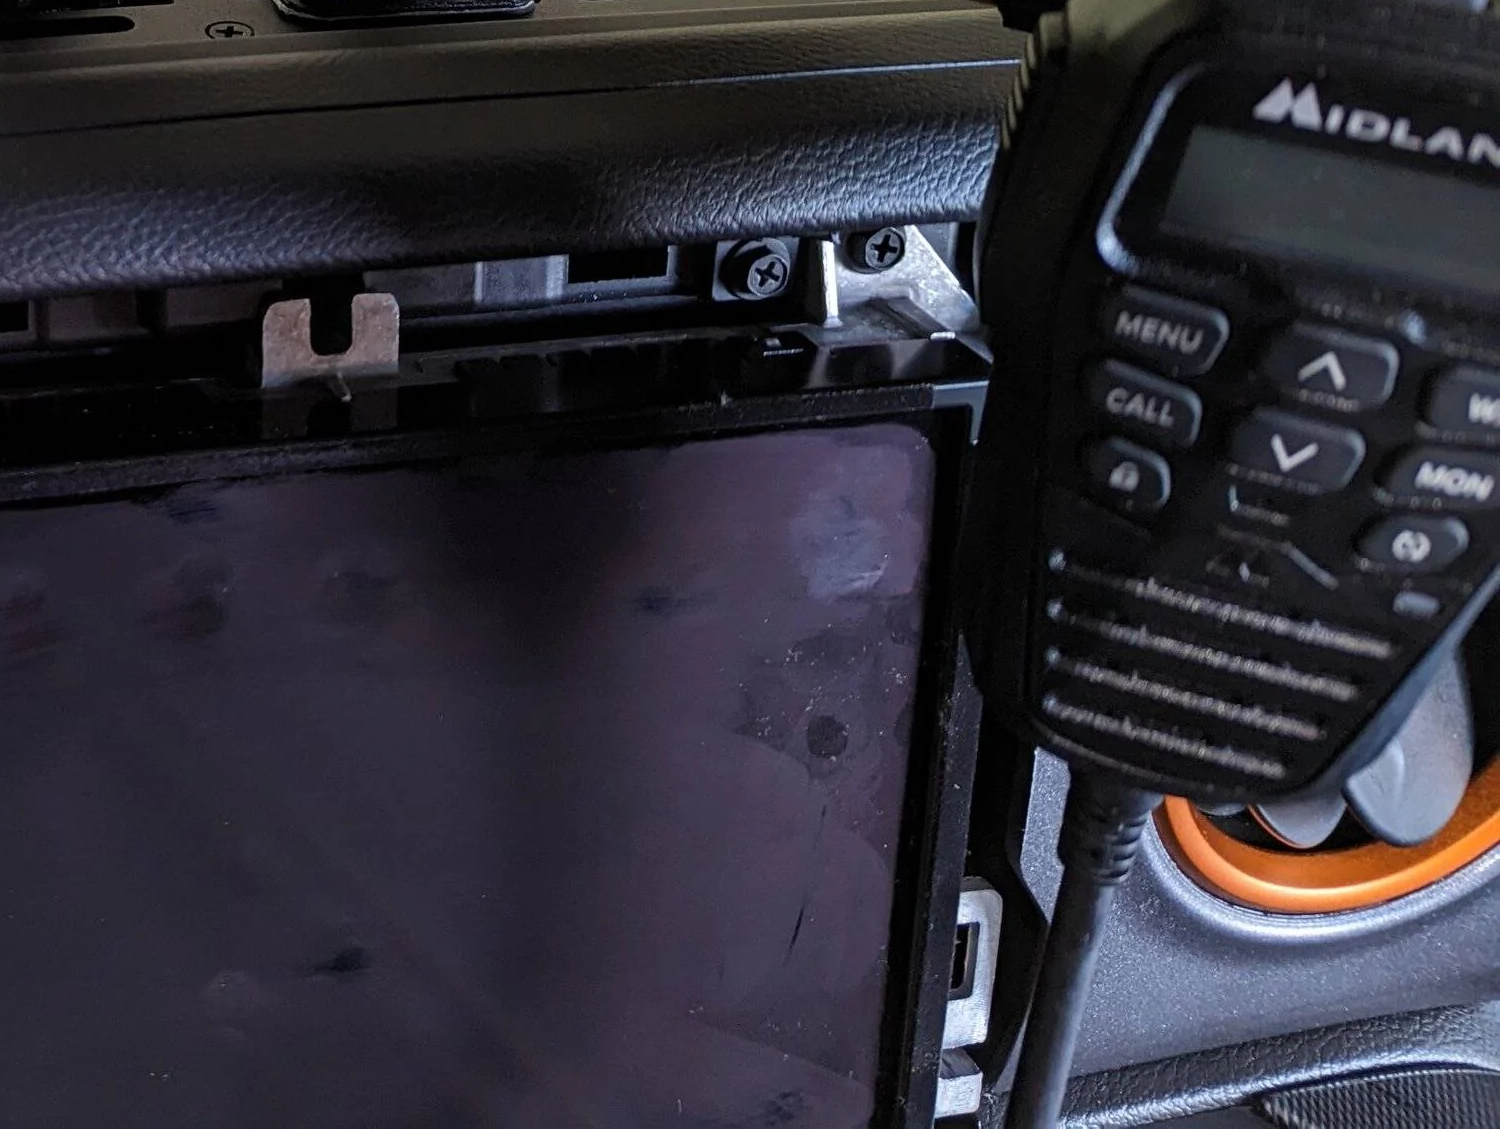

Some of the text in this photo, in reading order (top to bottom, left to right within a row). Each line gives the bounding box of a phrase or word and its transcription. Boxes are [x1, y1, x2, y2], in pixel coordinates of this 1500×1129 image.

[1115, 310, 1203, 355] MENU
[1105, 387, 1175, 427] CALL
[1414, 460, 1495, 502] MON
